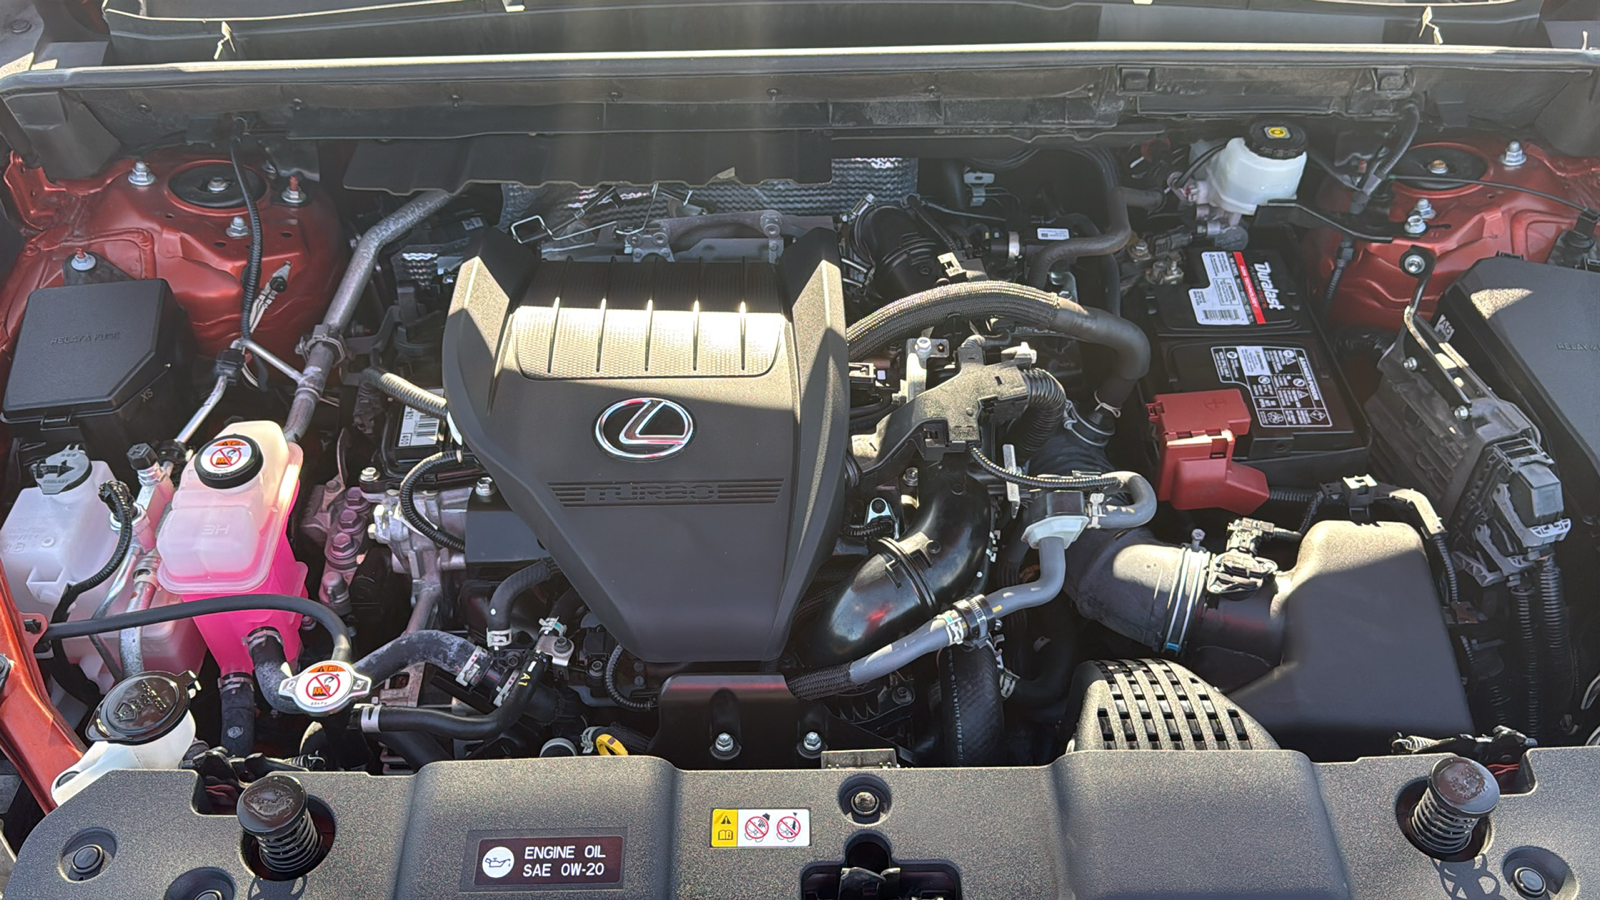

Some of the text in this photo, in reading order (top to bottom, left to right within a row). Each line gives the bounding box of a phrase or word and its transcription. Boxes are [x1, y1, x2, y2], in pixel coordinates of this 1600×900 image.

[1253, 261, 1286, 311] Duralast
[1556, 342, 1588, 351] RELAY
[588, 484, 715, 501] TURBO
[524, 845, 607, 860] ENGINE OIL
[522, 862, 605, 877] SAE 0W-20
